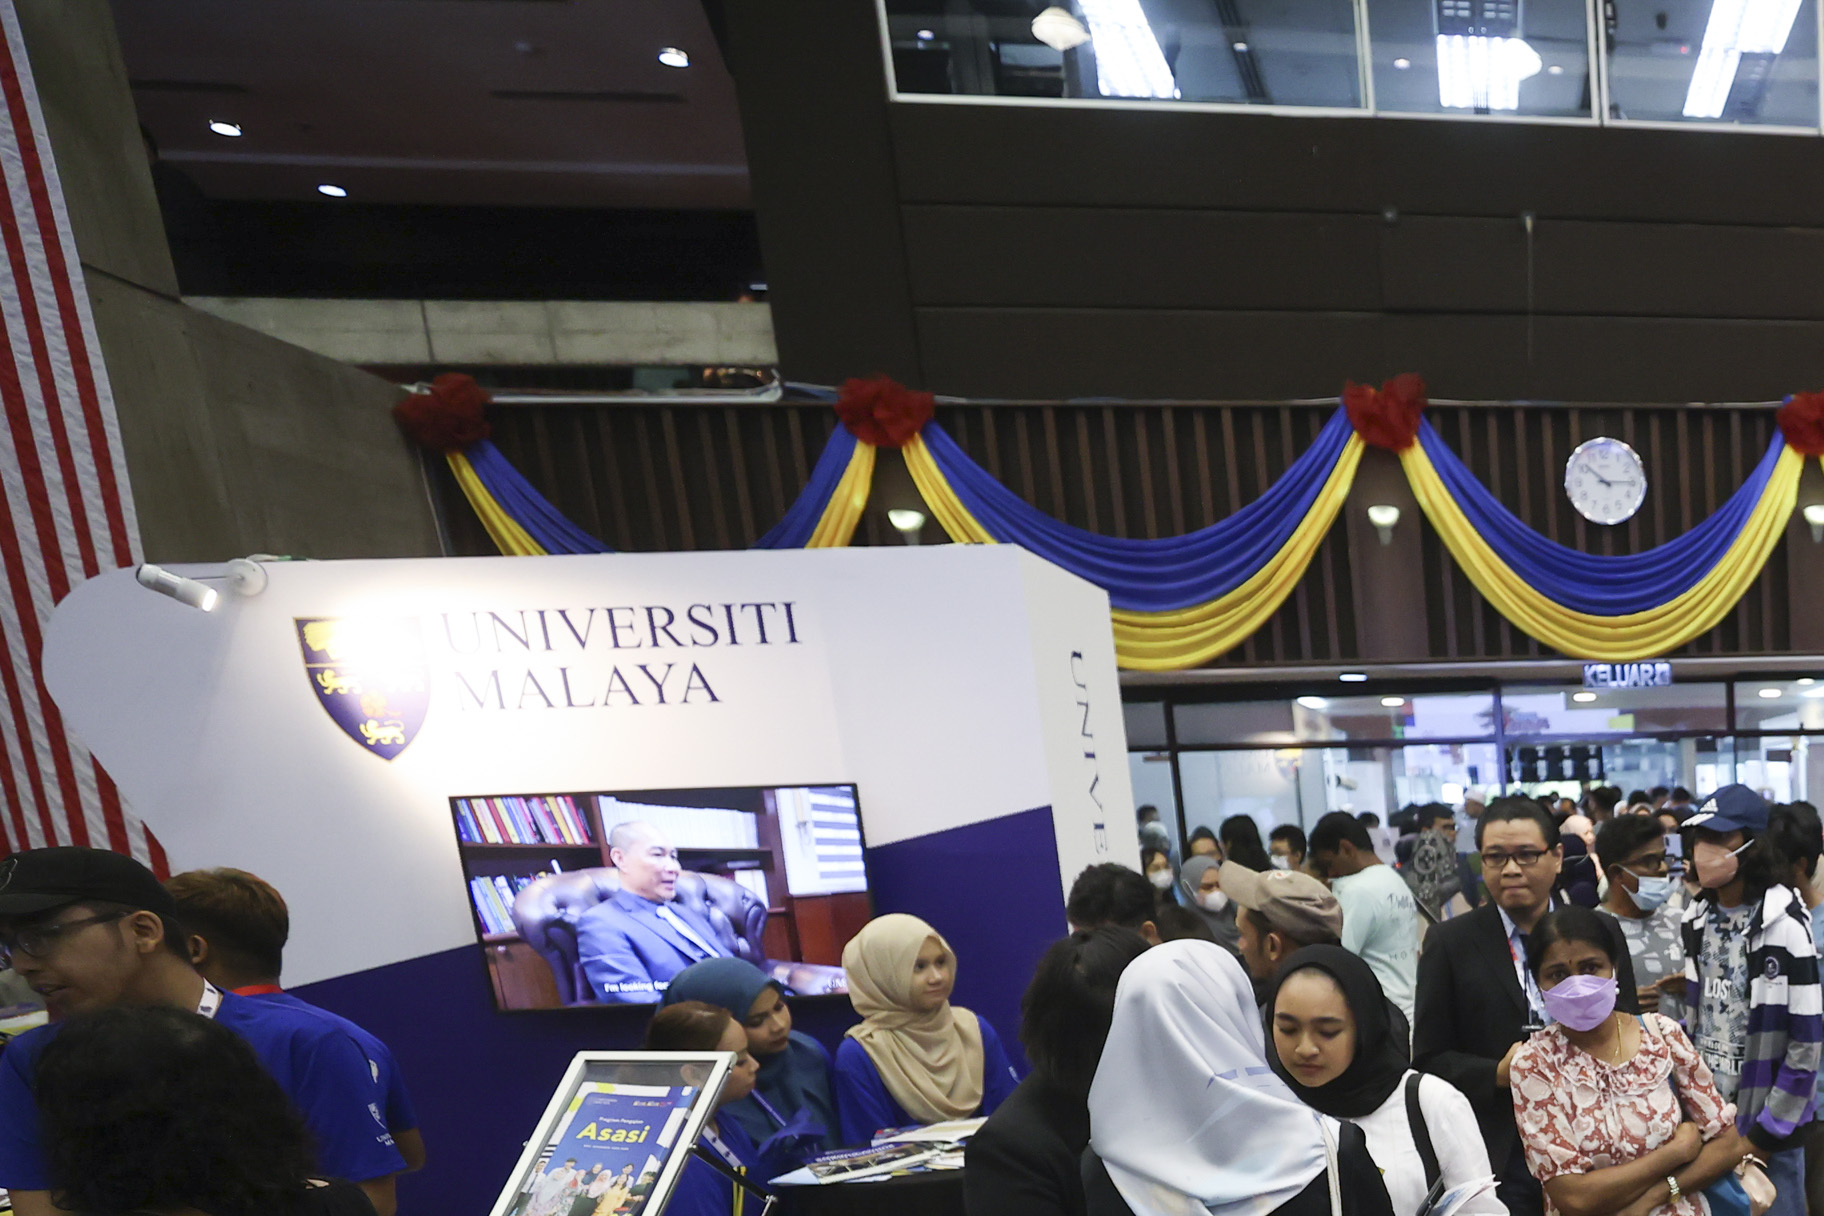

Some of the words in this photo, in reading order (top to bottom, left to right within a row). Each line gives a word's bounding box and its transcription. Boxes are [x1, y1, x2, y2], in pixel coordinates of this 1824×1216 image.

[440, 602, 801, 654] UNIVERSITI
[454, 662, 724, 711] MALAYA
[1583, 664, 1652, 687] KELUAR
[576, 1122, 651, 1143] Asasi
